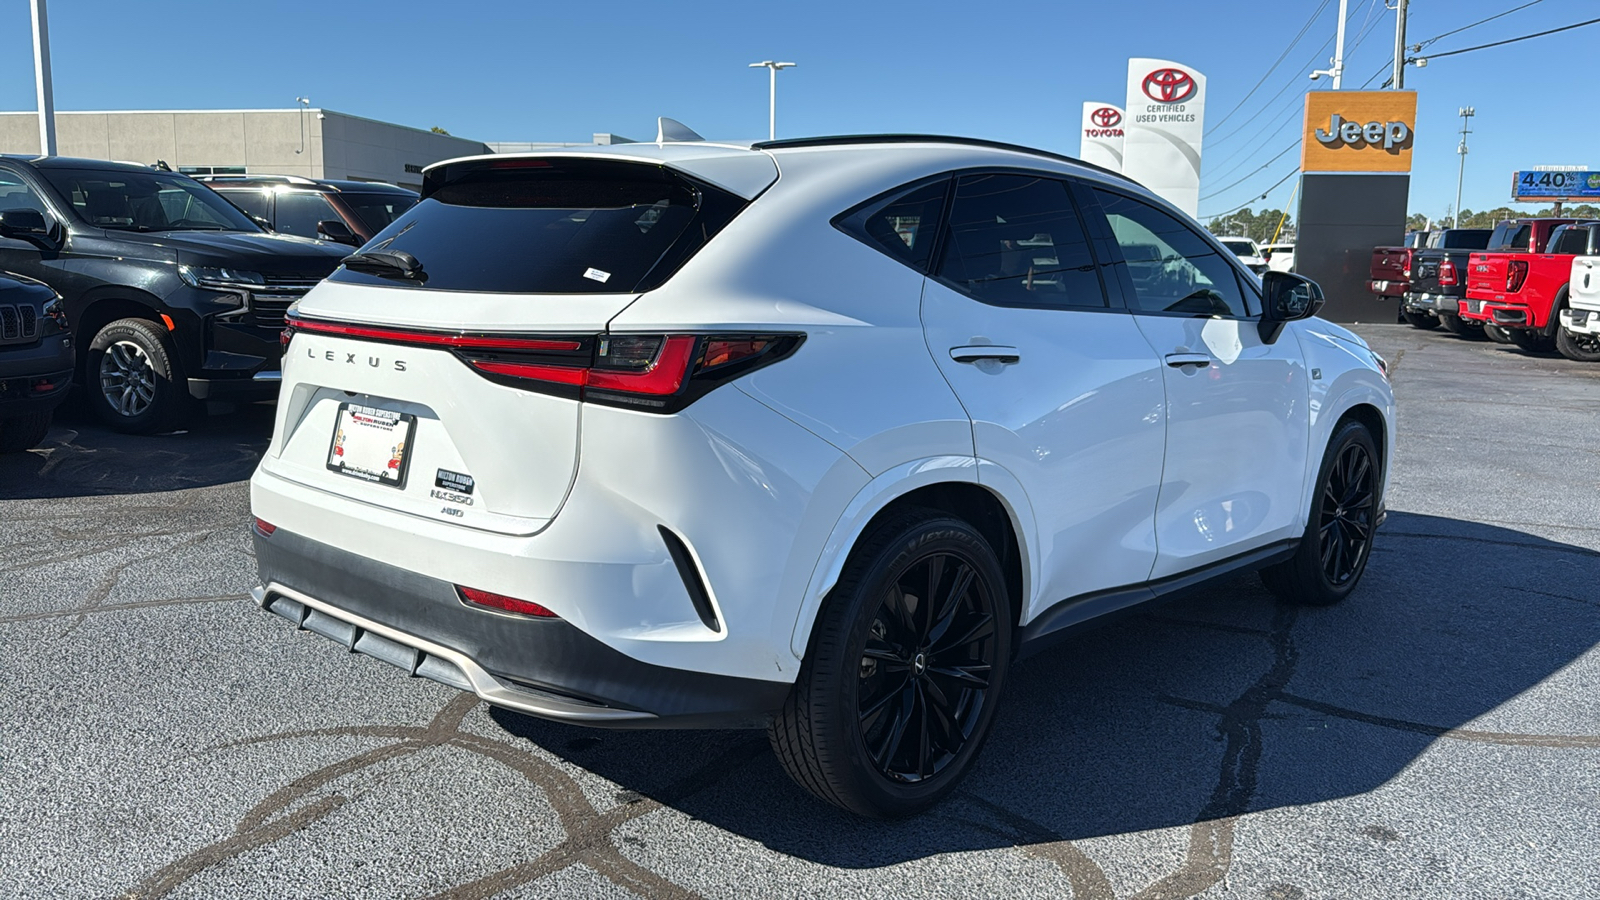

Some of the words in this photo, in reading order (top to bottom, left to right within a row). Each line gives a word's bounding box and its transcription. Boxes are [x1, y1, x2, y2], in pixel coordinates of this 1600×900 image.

[1146, 104, 1186, 113] CERTIFIED
[1136, 114, 1157, 123] USED
[1158, 114, 1196, 123] VEHICLES
[1084, 129, 1125, 138] TOYOTA
[1315, 113, 1408, 149] Jeep
[307, 348, 407, 372] LEXUS
[440, 507, 464, 518] AWD
